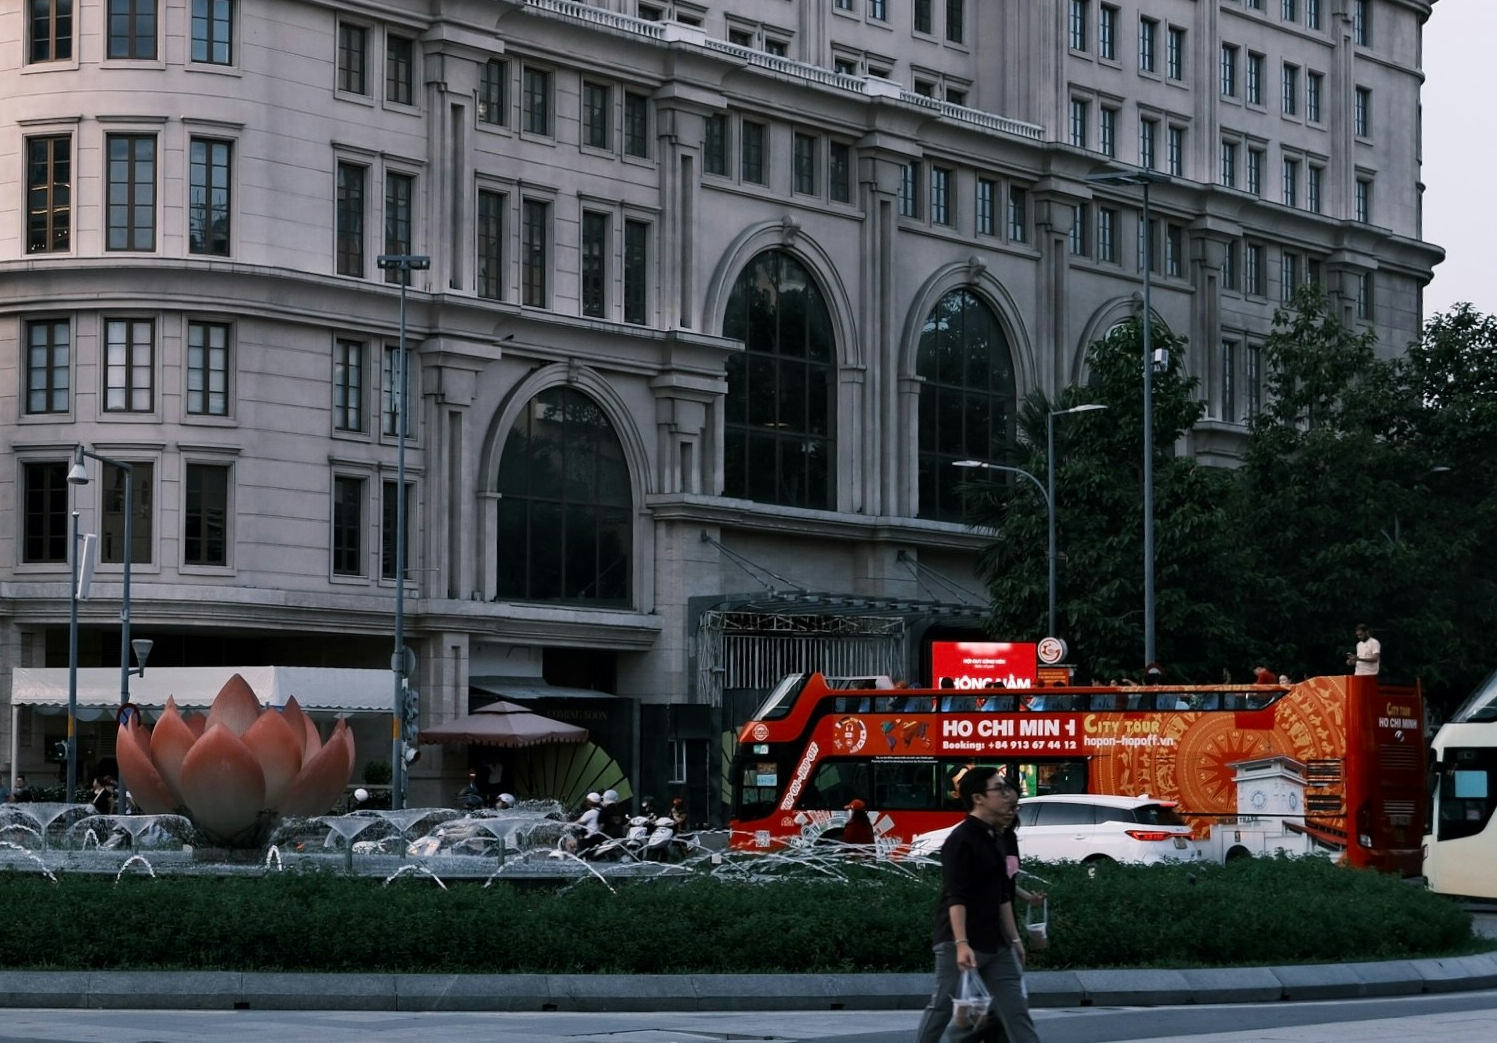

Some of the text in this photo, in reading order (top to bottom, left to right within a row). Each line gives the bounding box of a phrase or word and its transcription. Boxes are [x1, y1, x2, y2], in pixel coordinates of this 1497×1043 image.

[938, 675, 993, 690] HÔNG
[942, 719, 973, 737] HO
[977, 719, 1014, 737] CHI
[1378, 717, 1389, 728] HO
[1389, 718, 1402, 728] CHI
[942, 741, 1077, 751] Booking: +84 913 67 44 12
[1083, 735, 1174, 748] hopon-hopoff.vn
